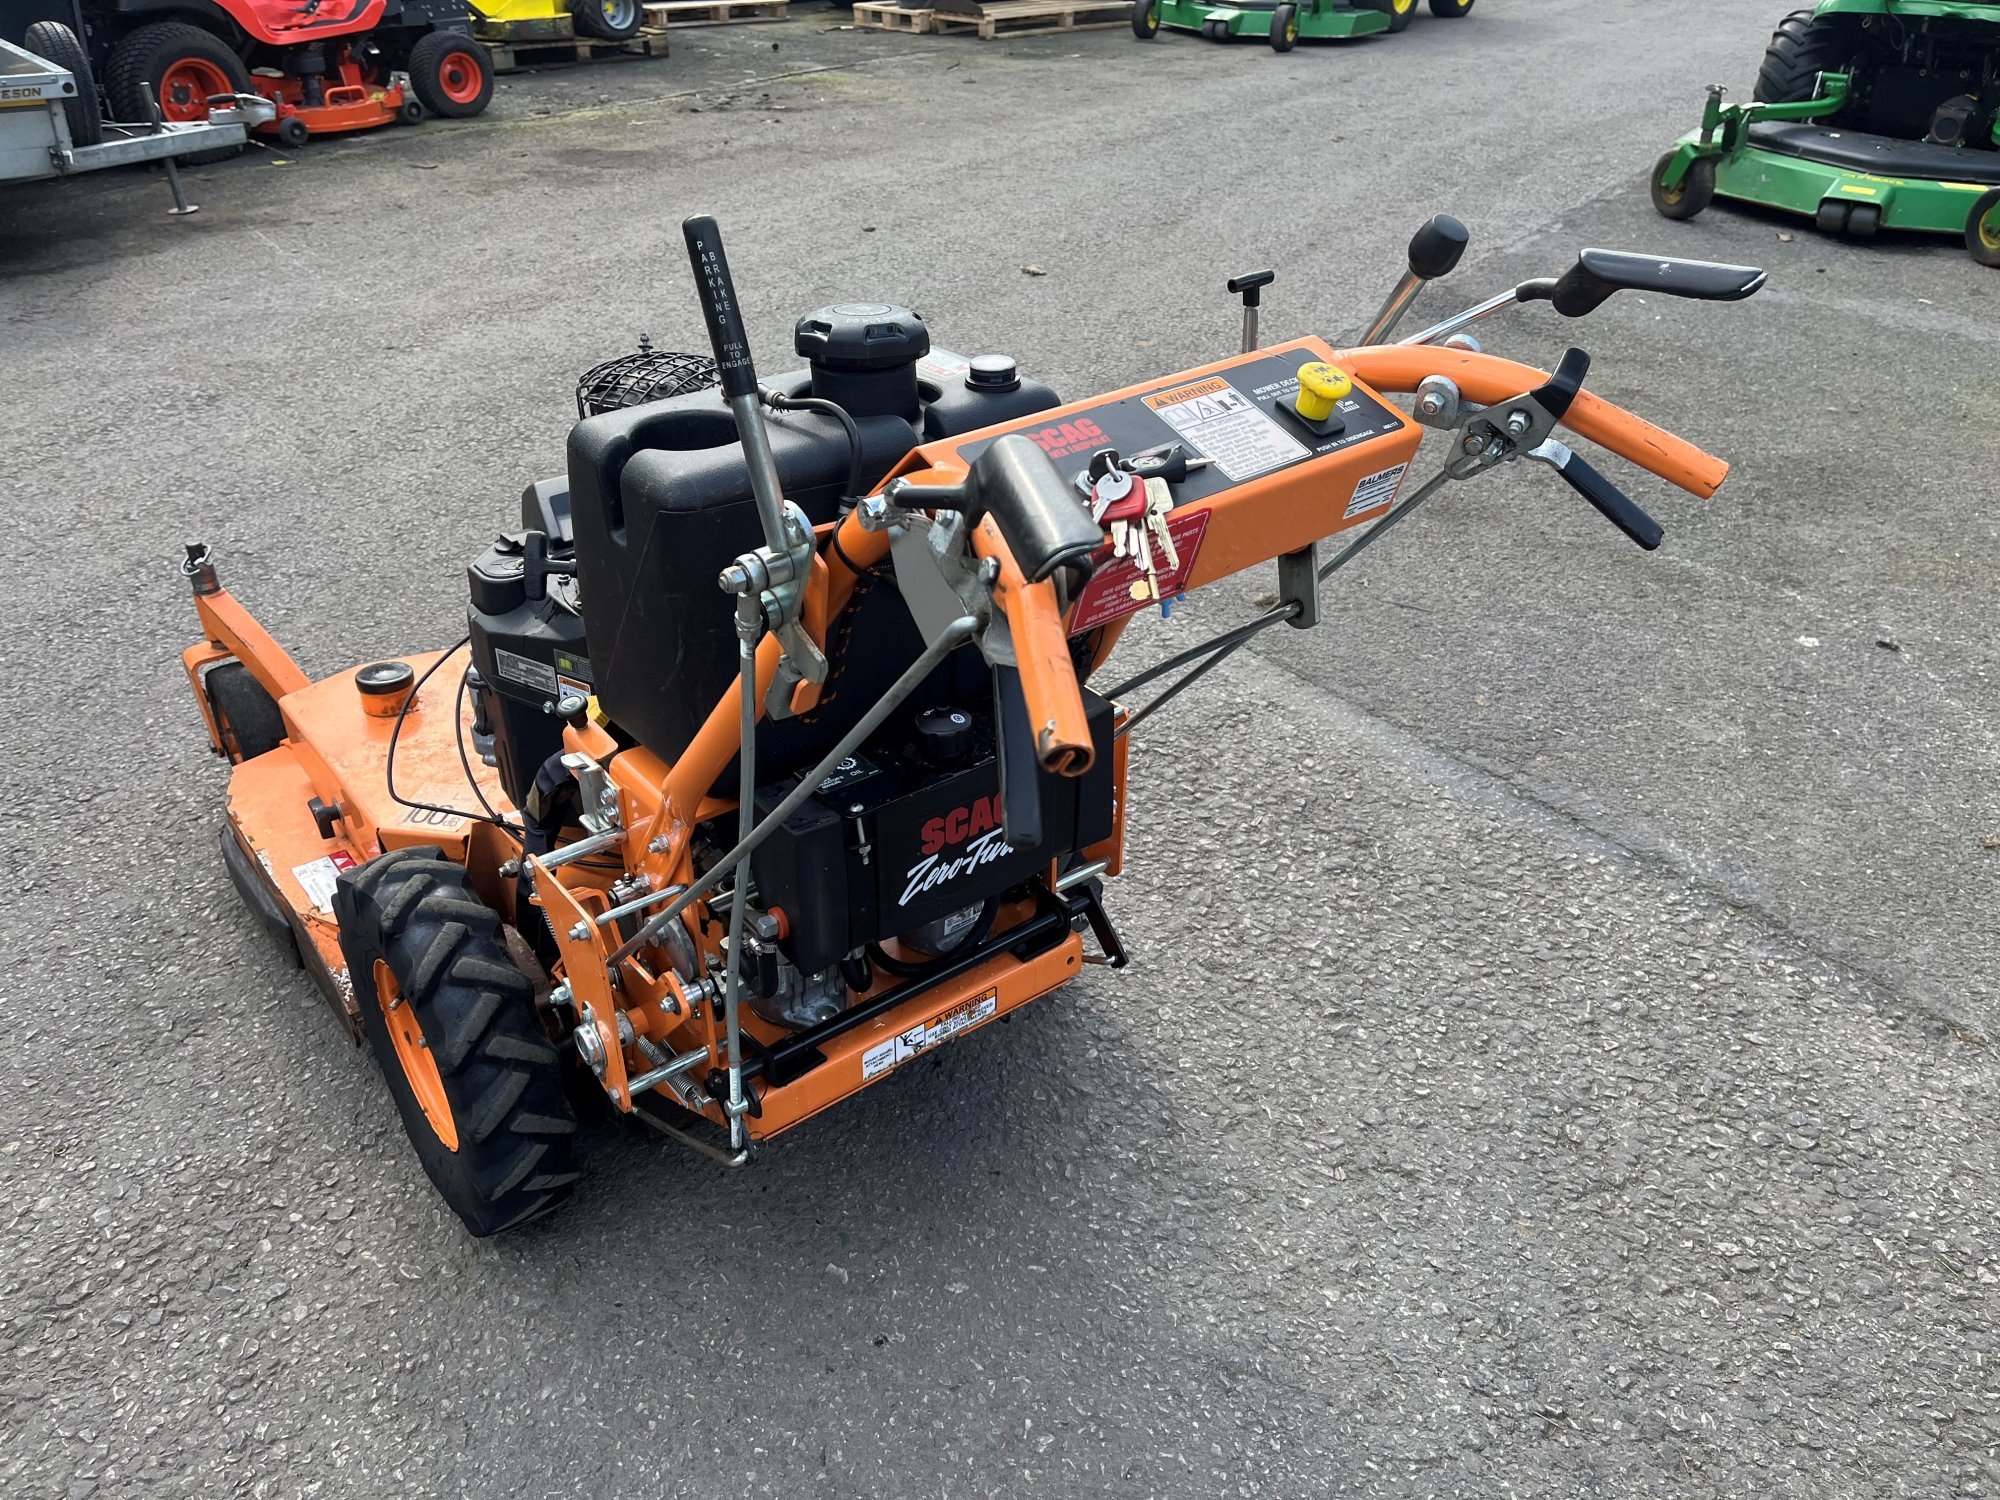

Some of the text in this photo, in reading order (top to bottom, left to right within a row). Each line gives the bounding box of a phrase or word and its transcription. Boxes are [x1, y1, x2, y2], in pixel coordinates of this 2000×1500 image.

[0, 87, 42, 99] ESON
[696, 241, 727, 325] PARKING
[708, 252, 731, 310] BRAKE
[723, 341, 744, 351] PULL
[721, 356, 751, 369] ENGAGE
[729, 350, 741, 359] TO
[1165, 382, 1223, 402] WARNING
[1252, 382, 1281, 395] MOWER
[1358, 465, 1405, 489] BALMERS
[944, 993, 988, 1020] WARNING
